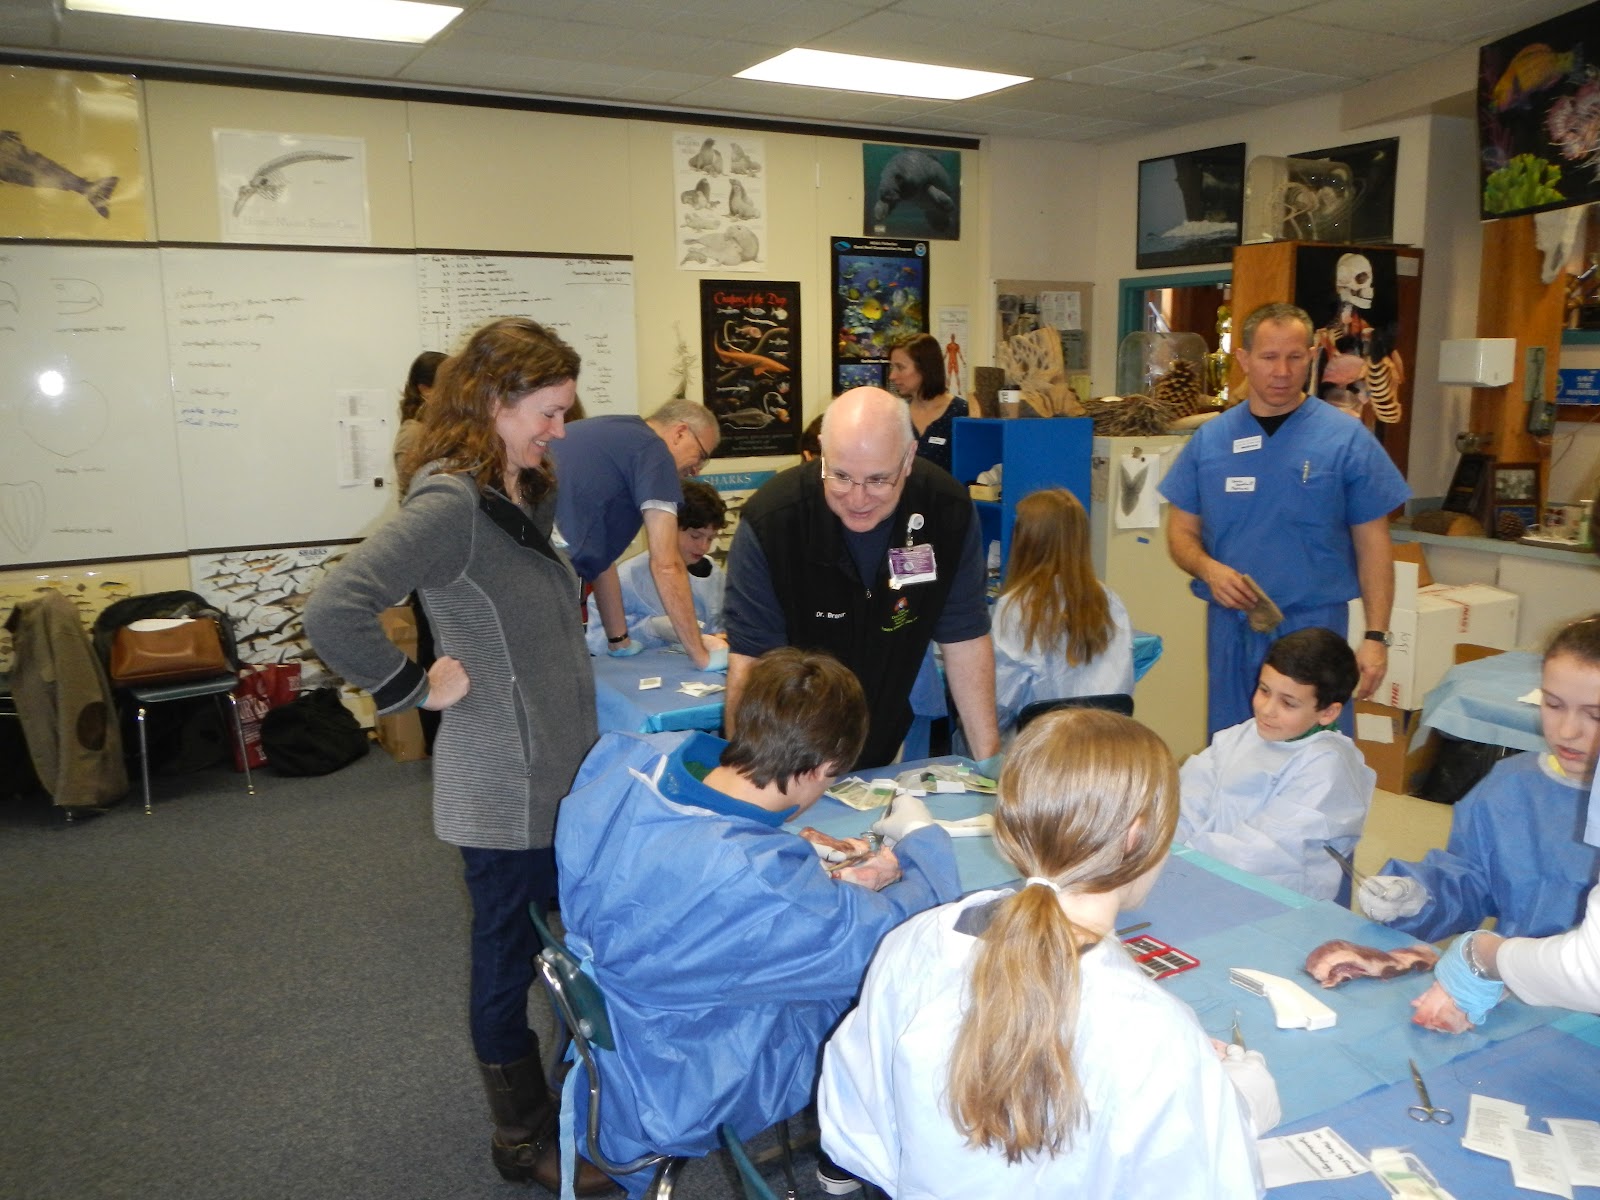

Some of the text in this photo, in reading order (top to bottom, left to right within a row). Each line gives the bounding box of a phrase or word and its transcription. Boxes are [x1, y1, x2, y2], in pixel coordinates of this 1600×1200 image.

[703, 473, 752, 486] SHARKS
[298, 548, 328, 557] SHARKS
[815, 610, 826, 618] Dr.
